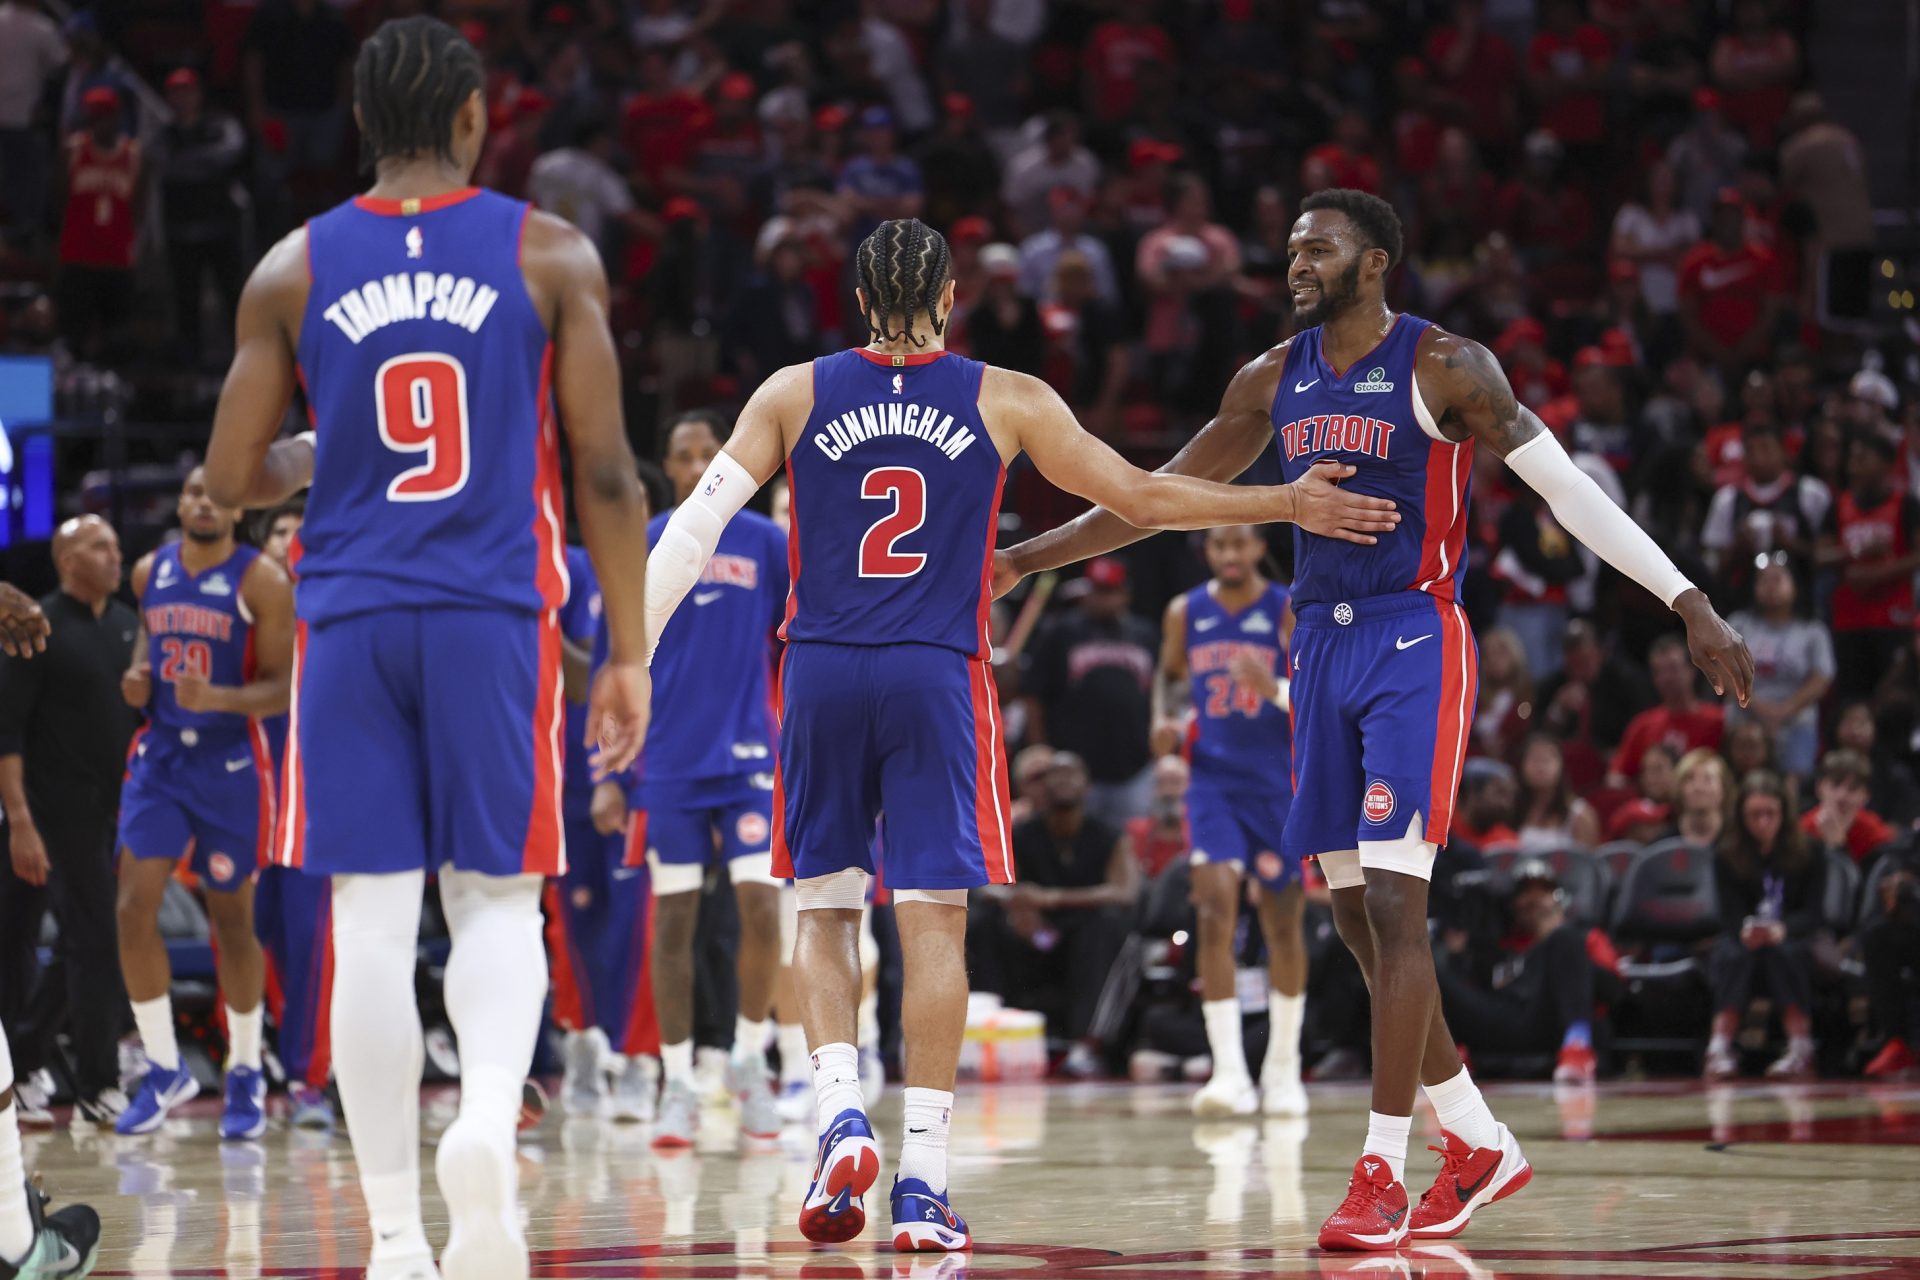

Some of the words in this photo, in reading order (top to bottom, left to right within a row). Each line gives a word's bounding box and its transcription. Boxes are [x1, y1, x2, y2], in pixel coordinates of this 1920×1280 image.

[323, 271, 499, 344] THOMPSON
[1355, 383, 1393, 392] StockX
[375, 352, 470, 502] 9
[813, 403, 976, 462] CUNNINGHAM
[1281, 414, 1396, 462] DETROIT
[858, 466, 928, 578] 2
